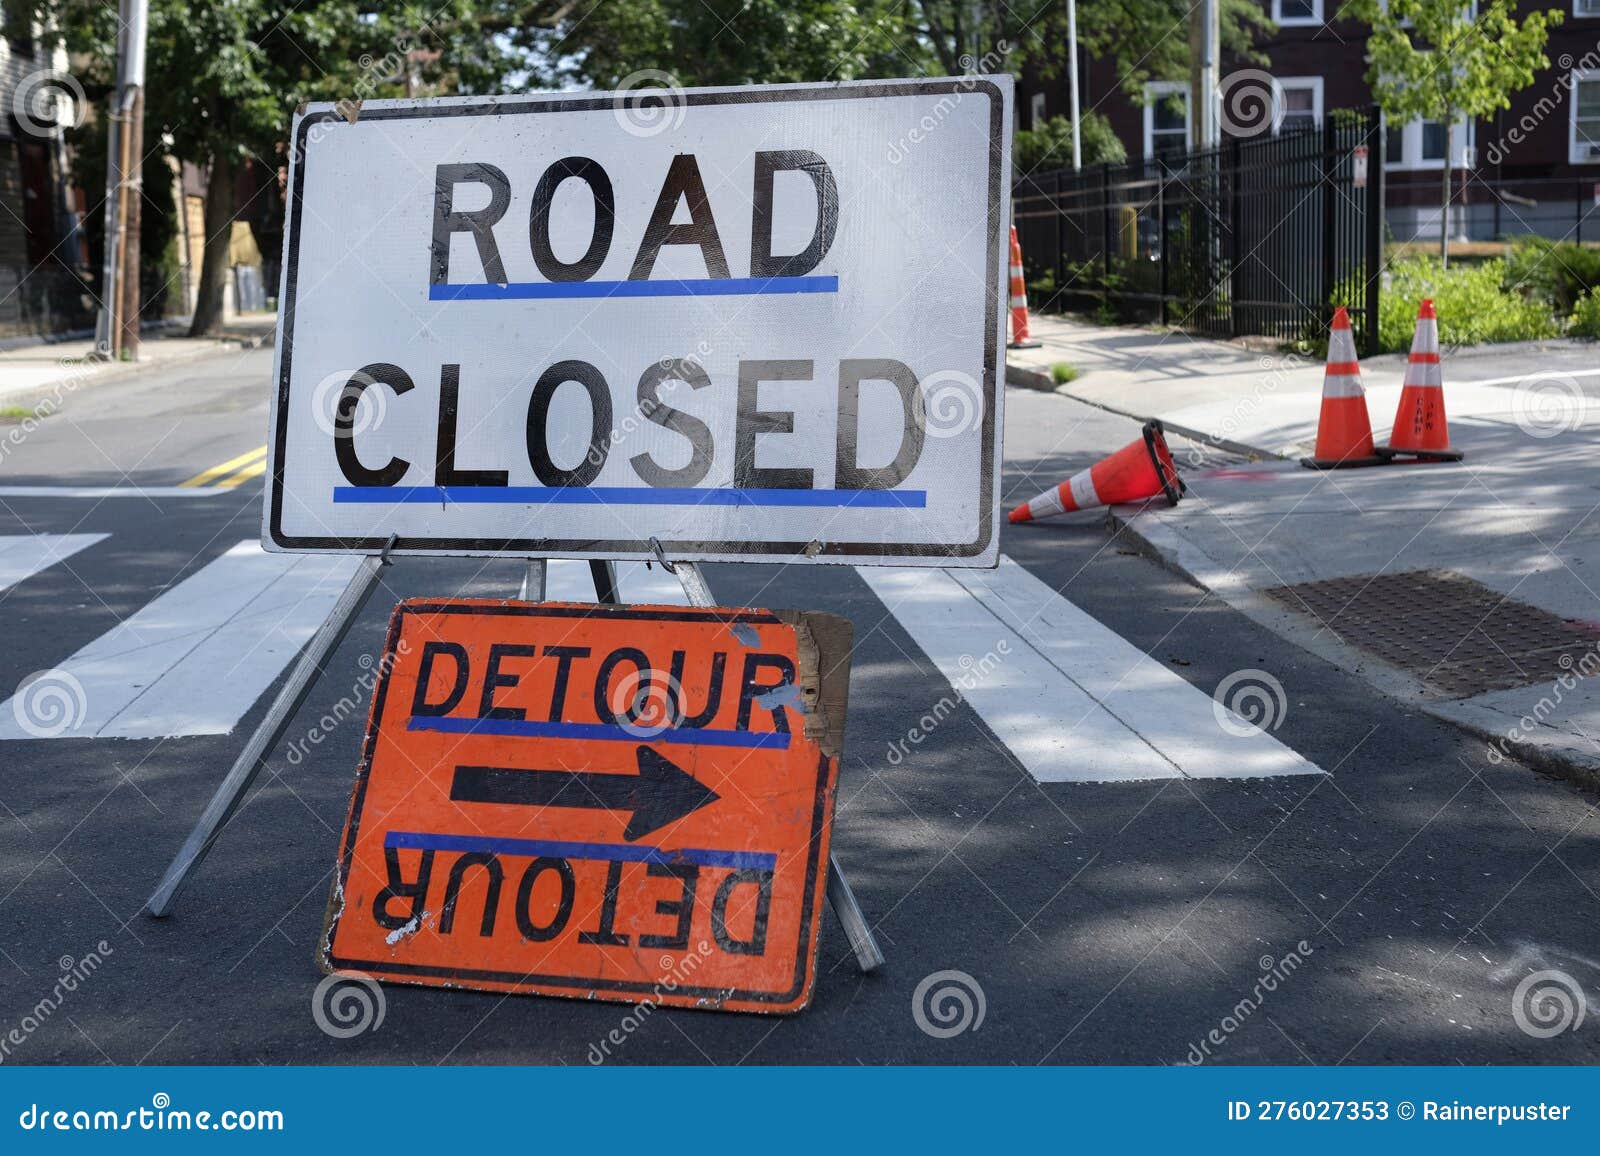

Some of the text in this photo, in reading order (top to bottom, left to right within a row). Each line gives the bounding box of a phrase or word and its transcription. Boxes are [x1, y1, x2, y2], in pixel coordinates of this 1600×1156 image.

[429, 149, 839, 285] ROAD
[334, 358, 926, 489] CLOSED
[410, 641, 797, 734] DETOUR
[372, 846, 777, 956] DETOUR
